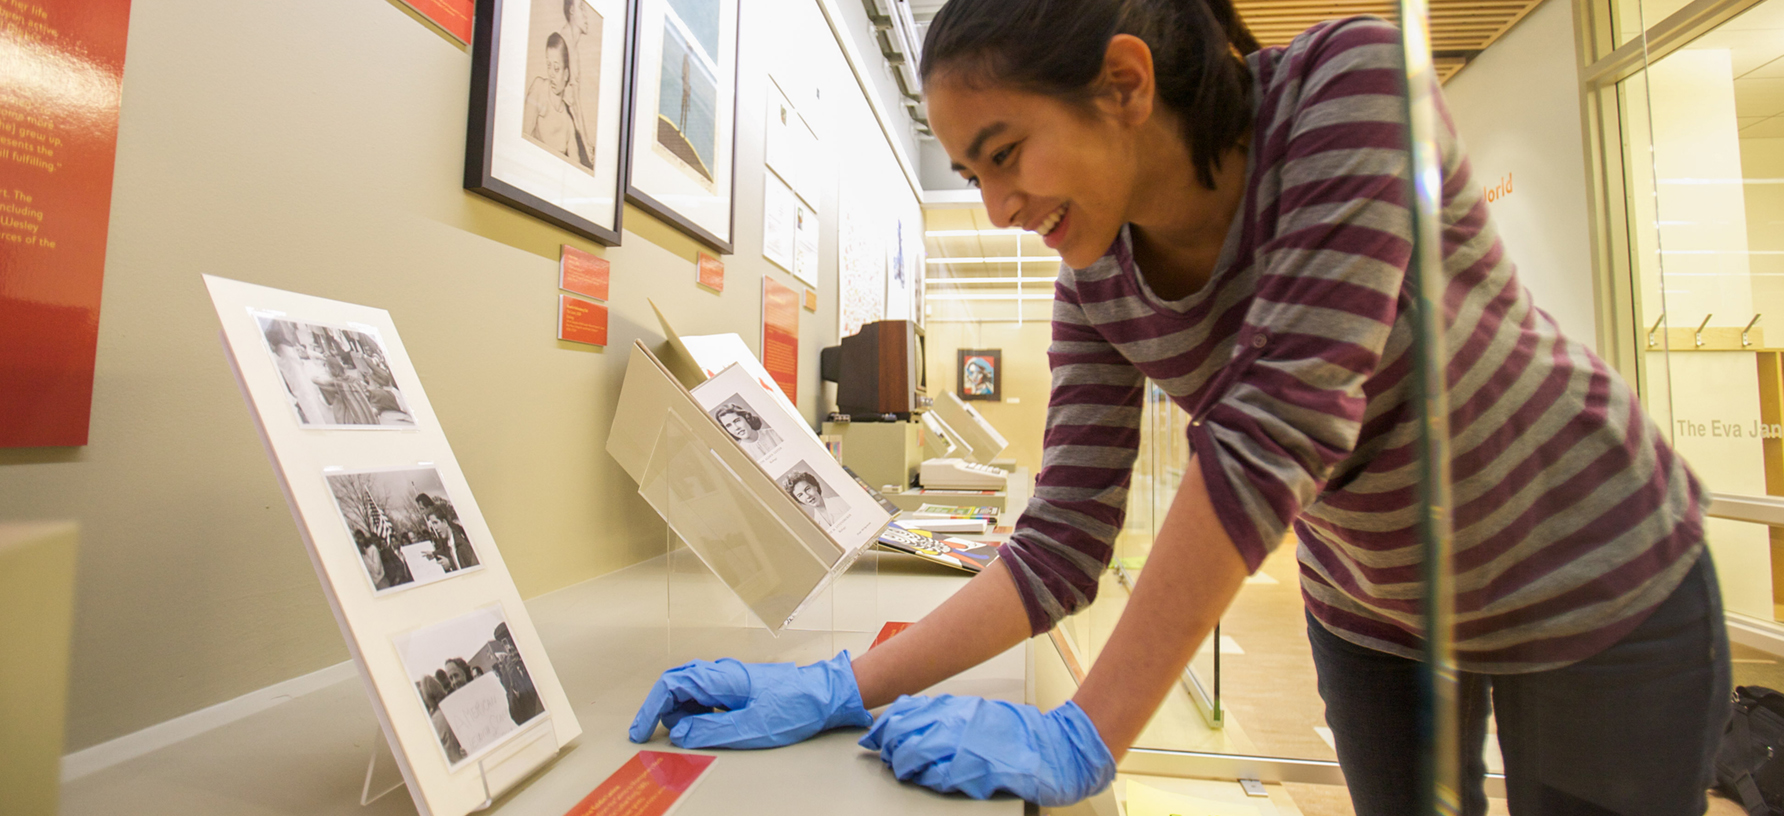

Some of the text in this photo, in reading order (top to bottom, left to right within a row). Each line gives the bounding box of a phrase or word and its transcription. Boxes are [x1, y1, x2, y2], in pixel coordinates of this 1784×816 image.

[19, 127, 46, 142] grew
[37, 144, 54, 157] the
[14, 189, 33, 203] The
[0, 214, 39, 234] Wesley
[25, 235, 37, 245] of
[39, 237, 56, 249] the
[1677, 419, 1706, 437] The
[1711, 419, 1742, 438] Eva
